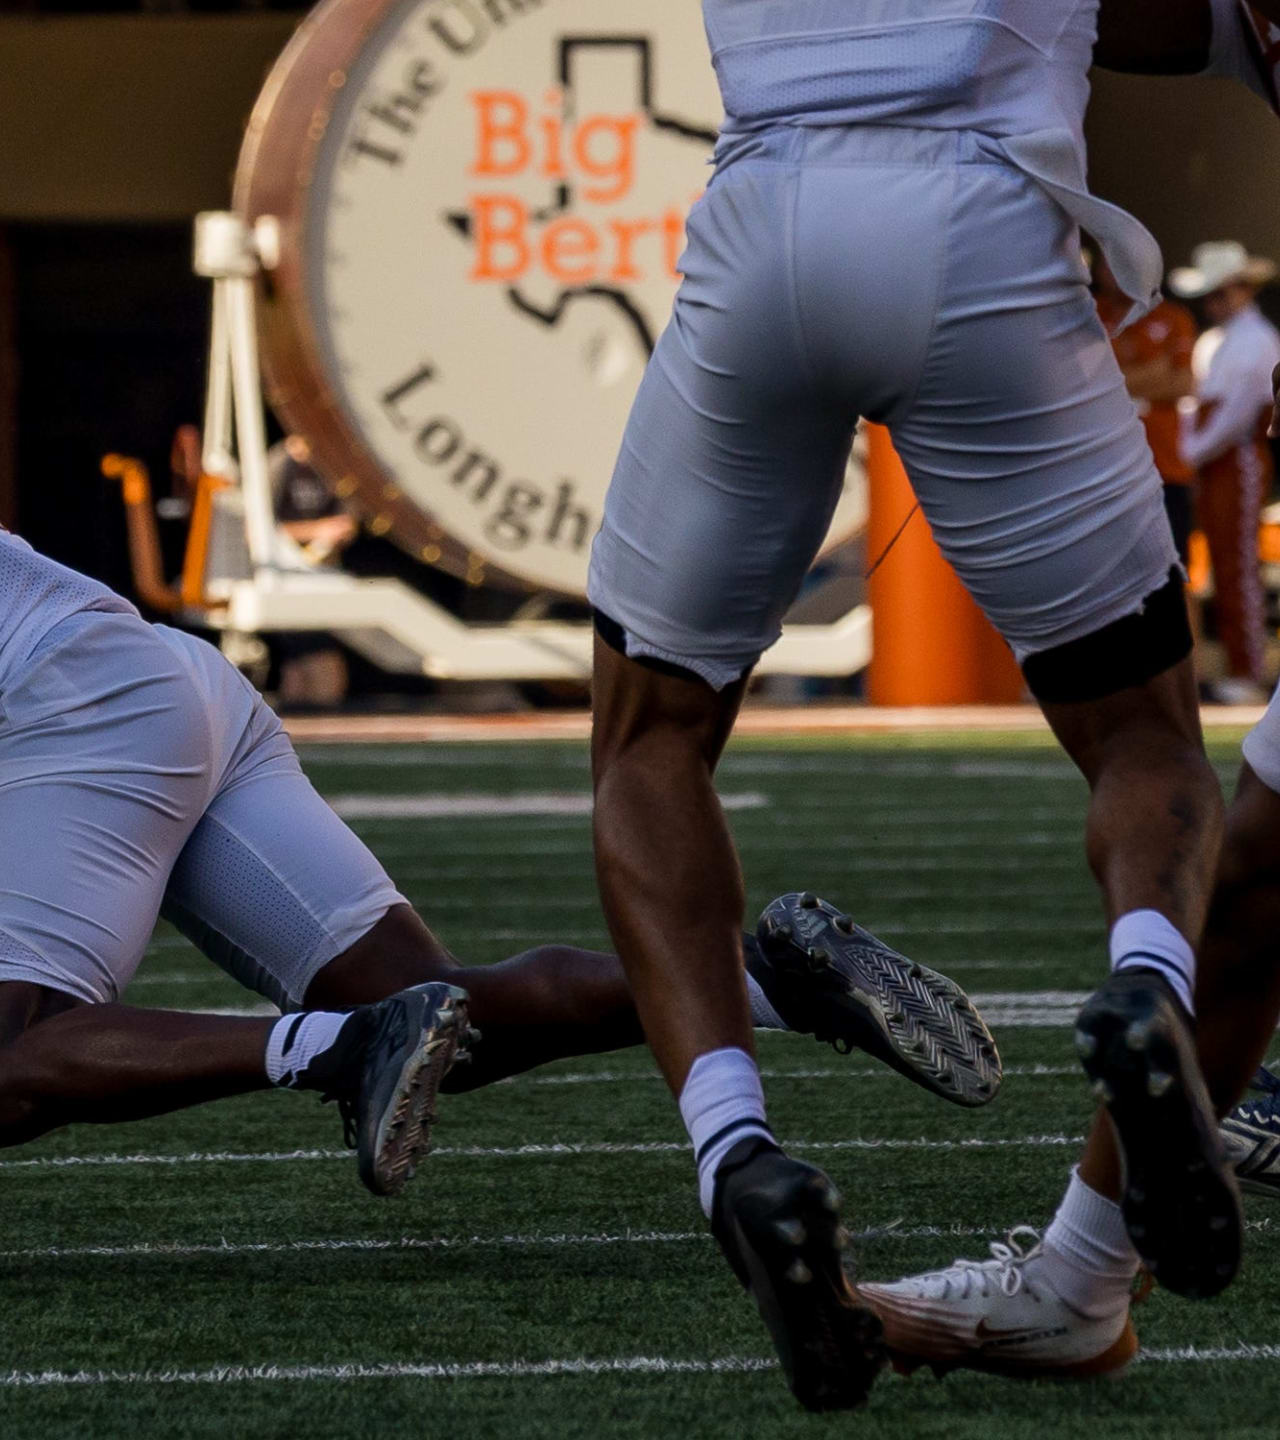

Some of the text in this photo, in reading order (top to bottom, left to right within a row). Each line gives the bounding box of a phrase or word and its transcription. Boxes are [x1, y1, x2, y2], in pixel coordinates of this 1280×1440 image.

[349, 60, 448, 167] The
[468, 90, 641, 205] Big
[468, 194, 703, 283] Bert
